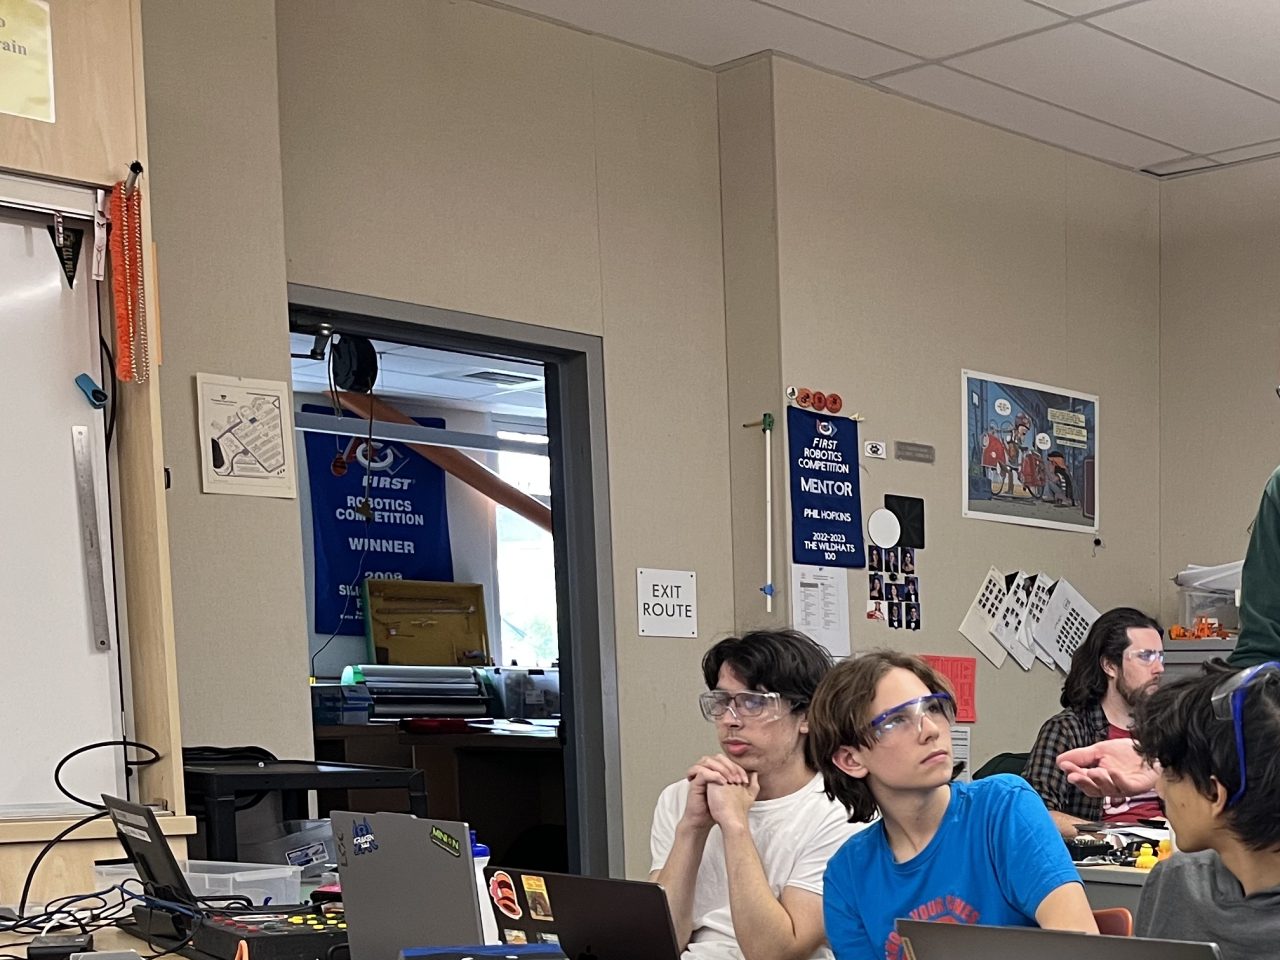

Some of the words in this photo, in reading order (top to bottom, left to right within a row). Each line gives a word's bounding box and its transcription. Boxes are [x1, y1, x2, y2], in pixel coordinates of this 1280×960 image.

[0, 39, 27, 56] ain
[812, 437, 838, 450] FIRST
[804, 447, 842, 462] ROBOTICS
[798, 457, 850, 474] COMPETITION
[362, 475, 412, 490] FIRST
[800, 476, 853, 497] MENTOR
[336, 508, 424, 525] COMETITION
[803, 508, 820, 519] PHIL
[821, 510, 852, 522] HOPKINS
[812, 532, 846, 543] 2022-2023
[348, 537, 415, 554] WINNER
[804, 540, 818, 550] THE
[819, 541, 856, 553] WILDHATS
[824, 552, 836, 560] 100
[652, 584, 682, 598] EXIT
[643, 602, 692, 618] ROUTE
